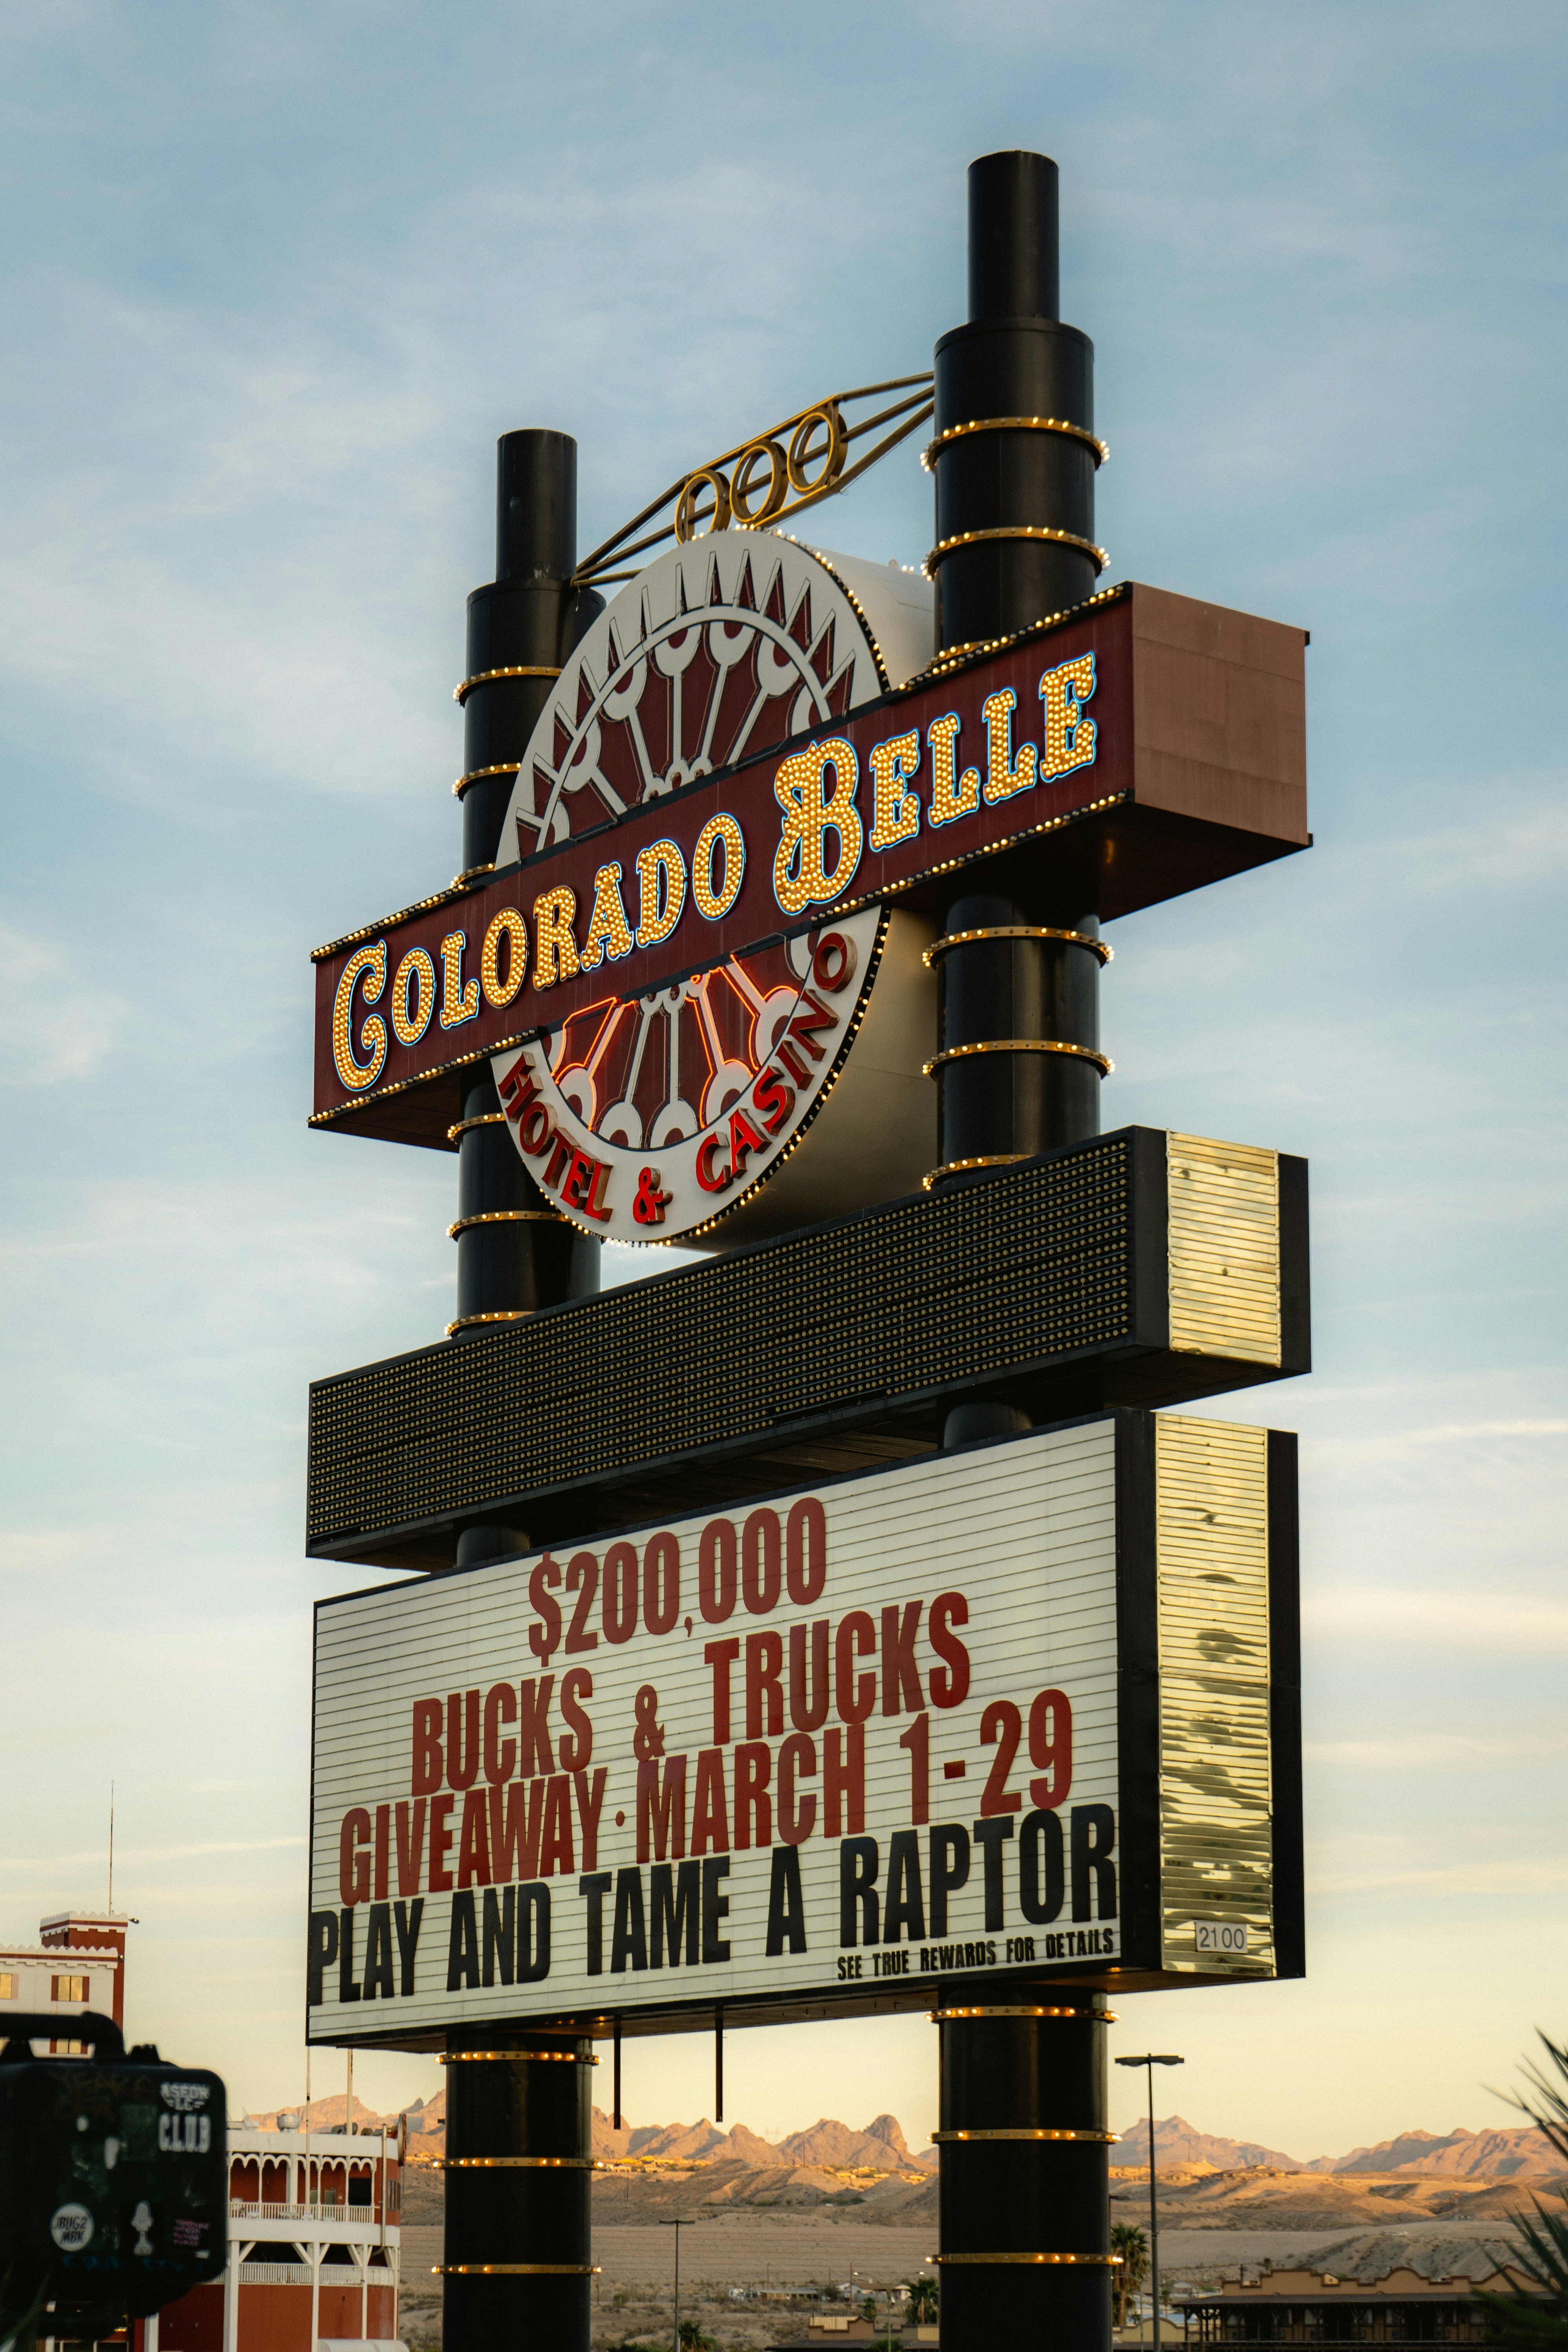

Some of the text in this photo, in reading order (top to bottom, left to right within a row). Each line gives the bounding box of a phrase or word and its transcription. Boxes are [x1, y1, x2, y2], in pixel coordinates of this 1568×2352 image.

[333, 652, 1098, 1091] COLORADO BELLE
[497, 932, 857, 1225] HOTEL & CASINO
[529, 1498, 825, 1667] $200,000
[412, 1592, 970, 1797] BUCKS & TRUCKS
[900, 1689, 1072, 1824] 1-29
[310, 1803, 1117, 2006] PLAY AND TAME A RAPTOR
[837, 1927, 1114, 1980] SEE TRUE REWARDS FOR DETAILS
[1199, 1926, 1244, 1949] 2100
